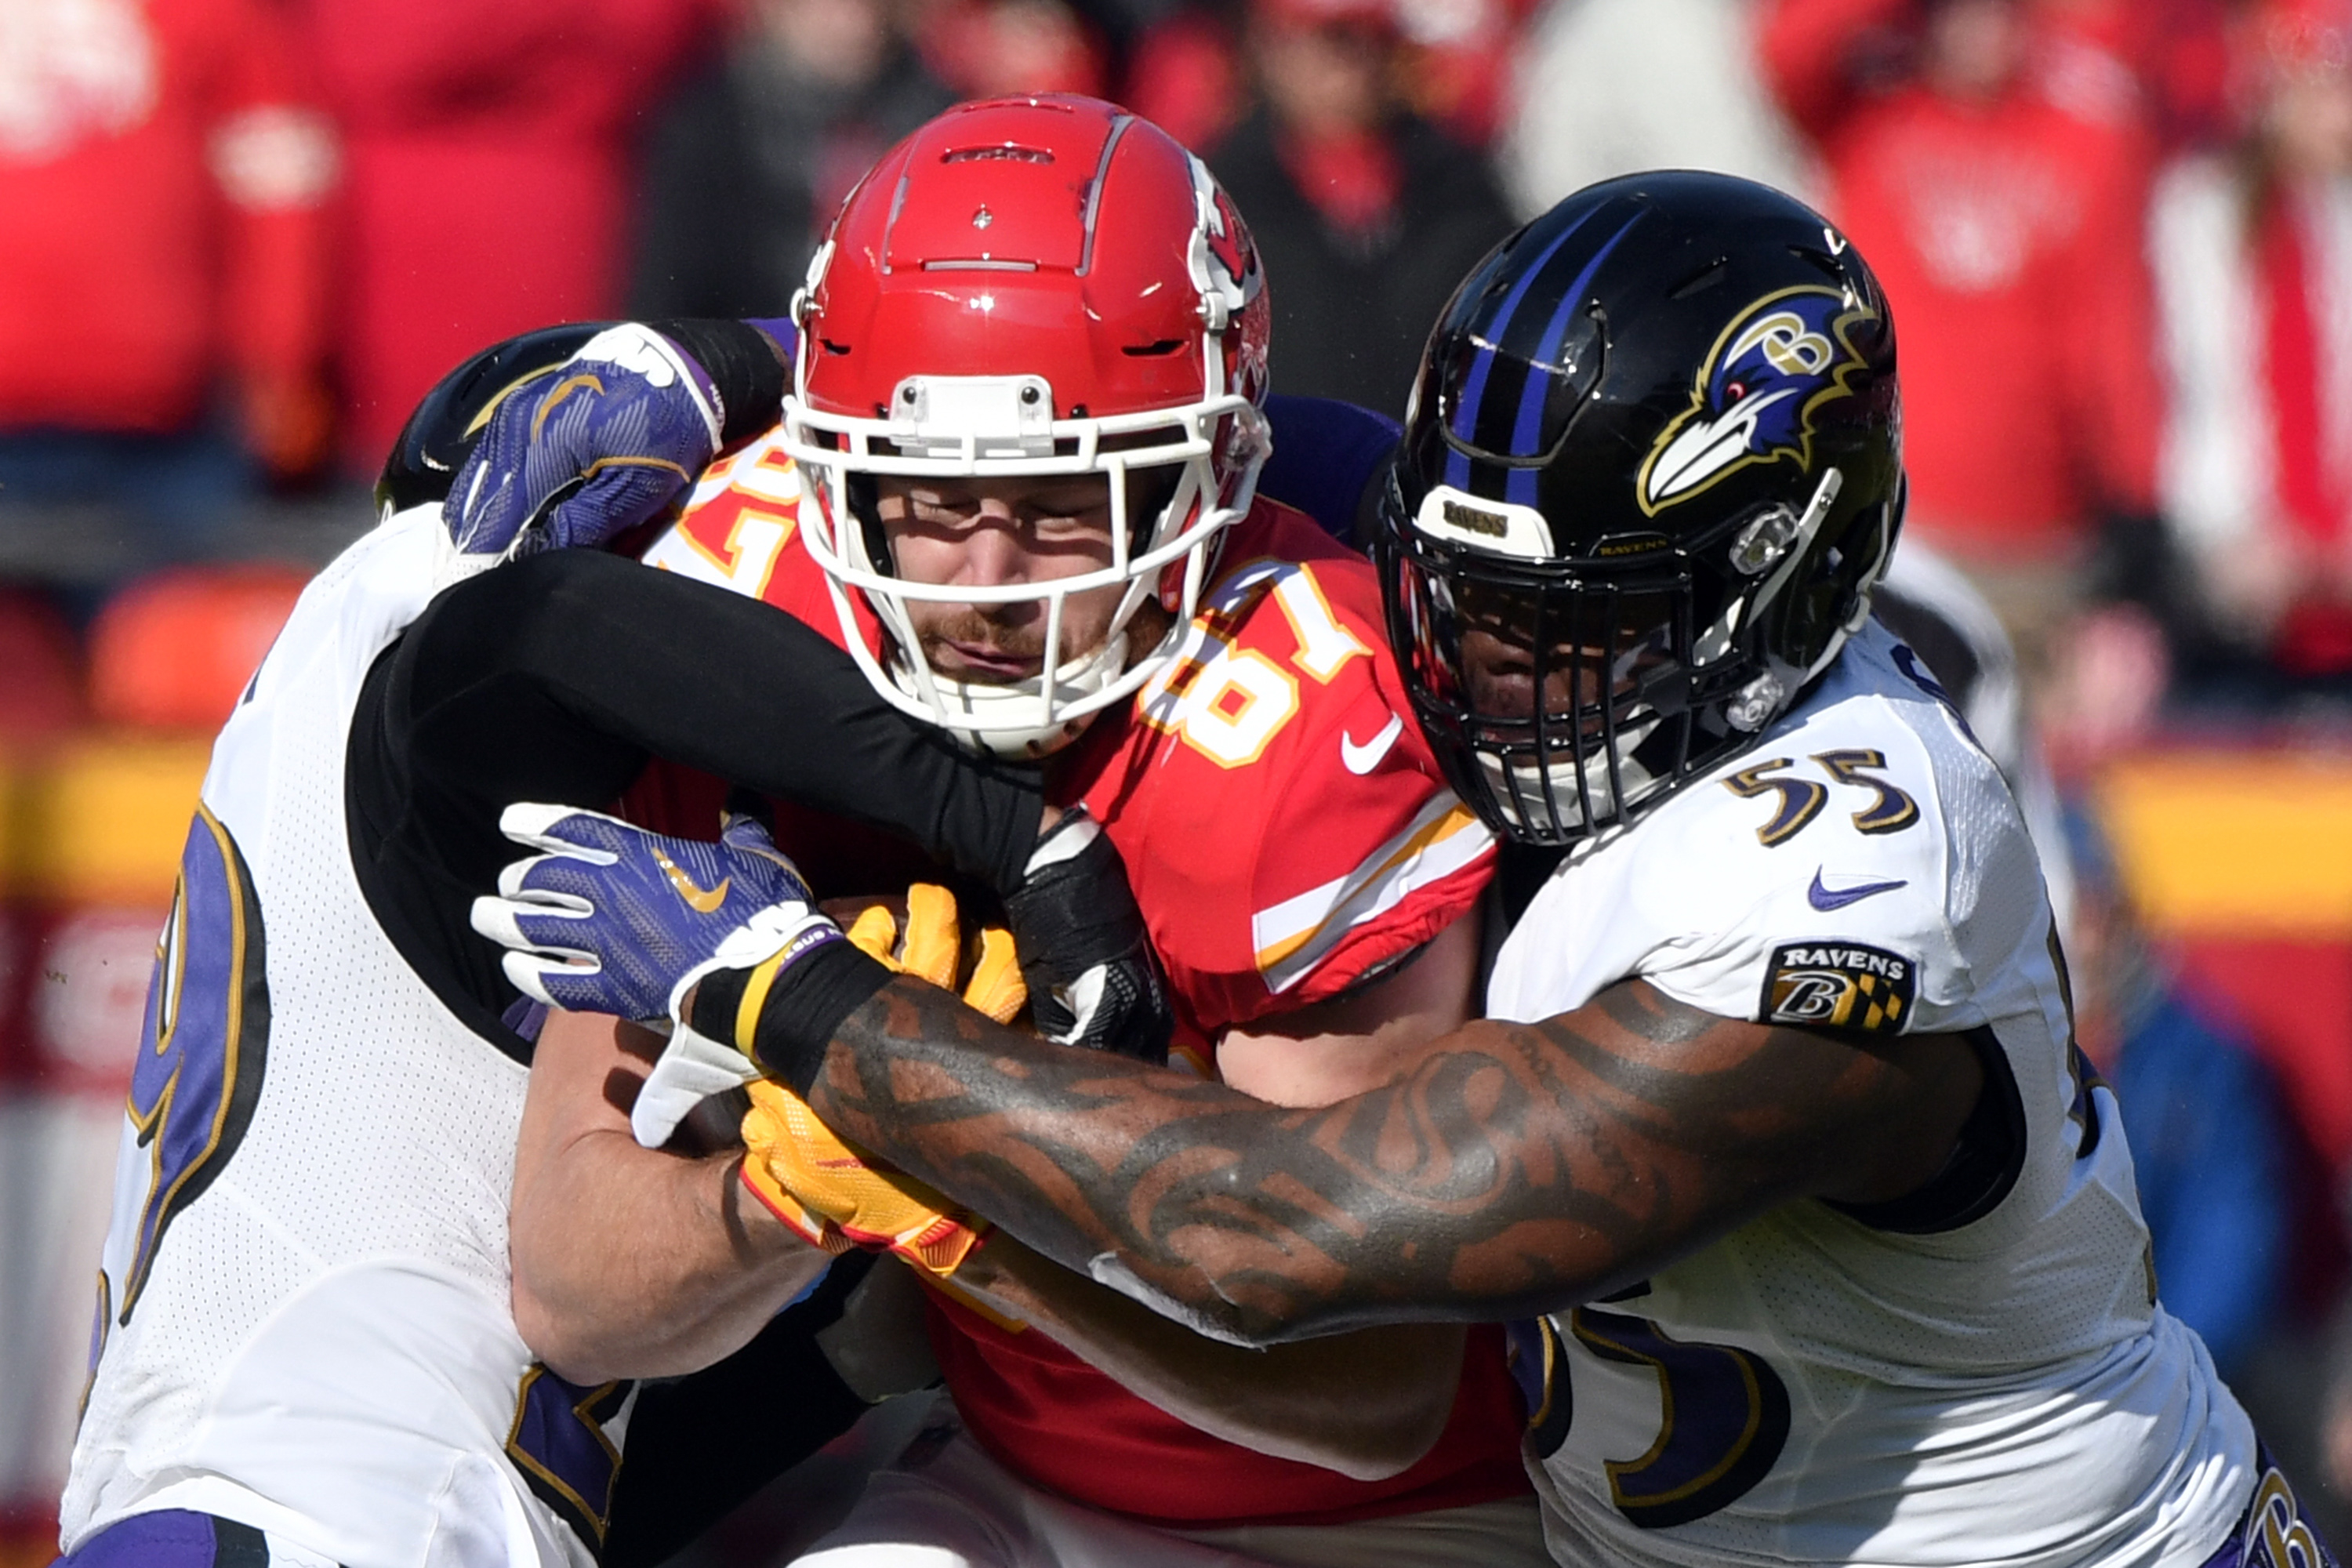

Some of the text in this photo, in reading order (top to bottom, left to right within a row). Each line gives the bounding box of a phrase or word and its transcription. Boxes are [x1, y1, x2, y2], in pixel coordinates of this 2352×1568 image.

[1138, 556, 1375, 771] 87
[1720, 748, 1921, 848] 55
[1770, 970, 1849, 1024] B
[1783, 949, 1905, 980] RAVENS
